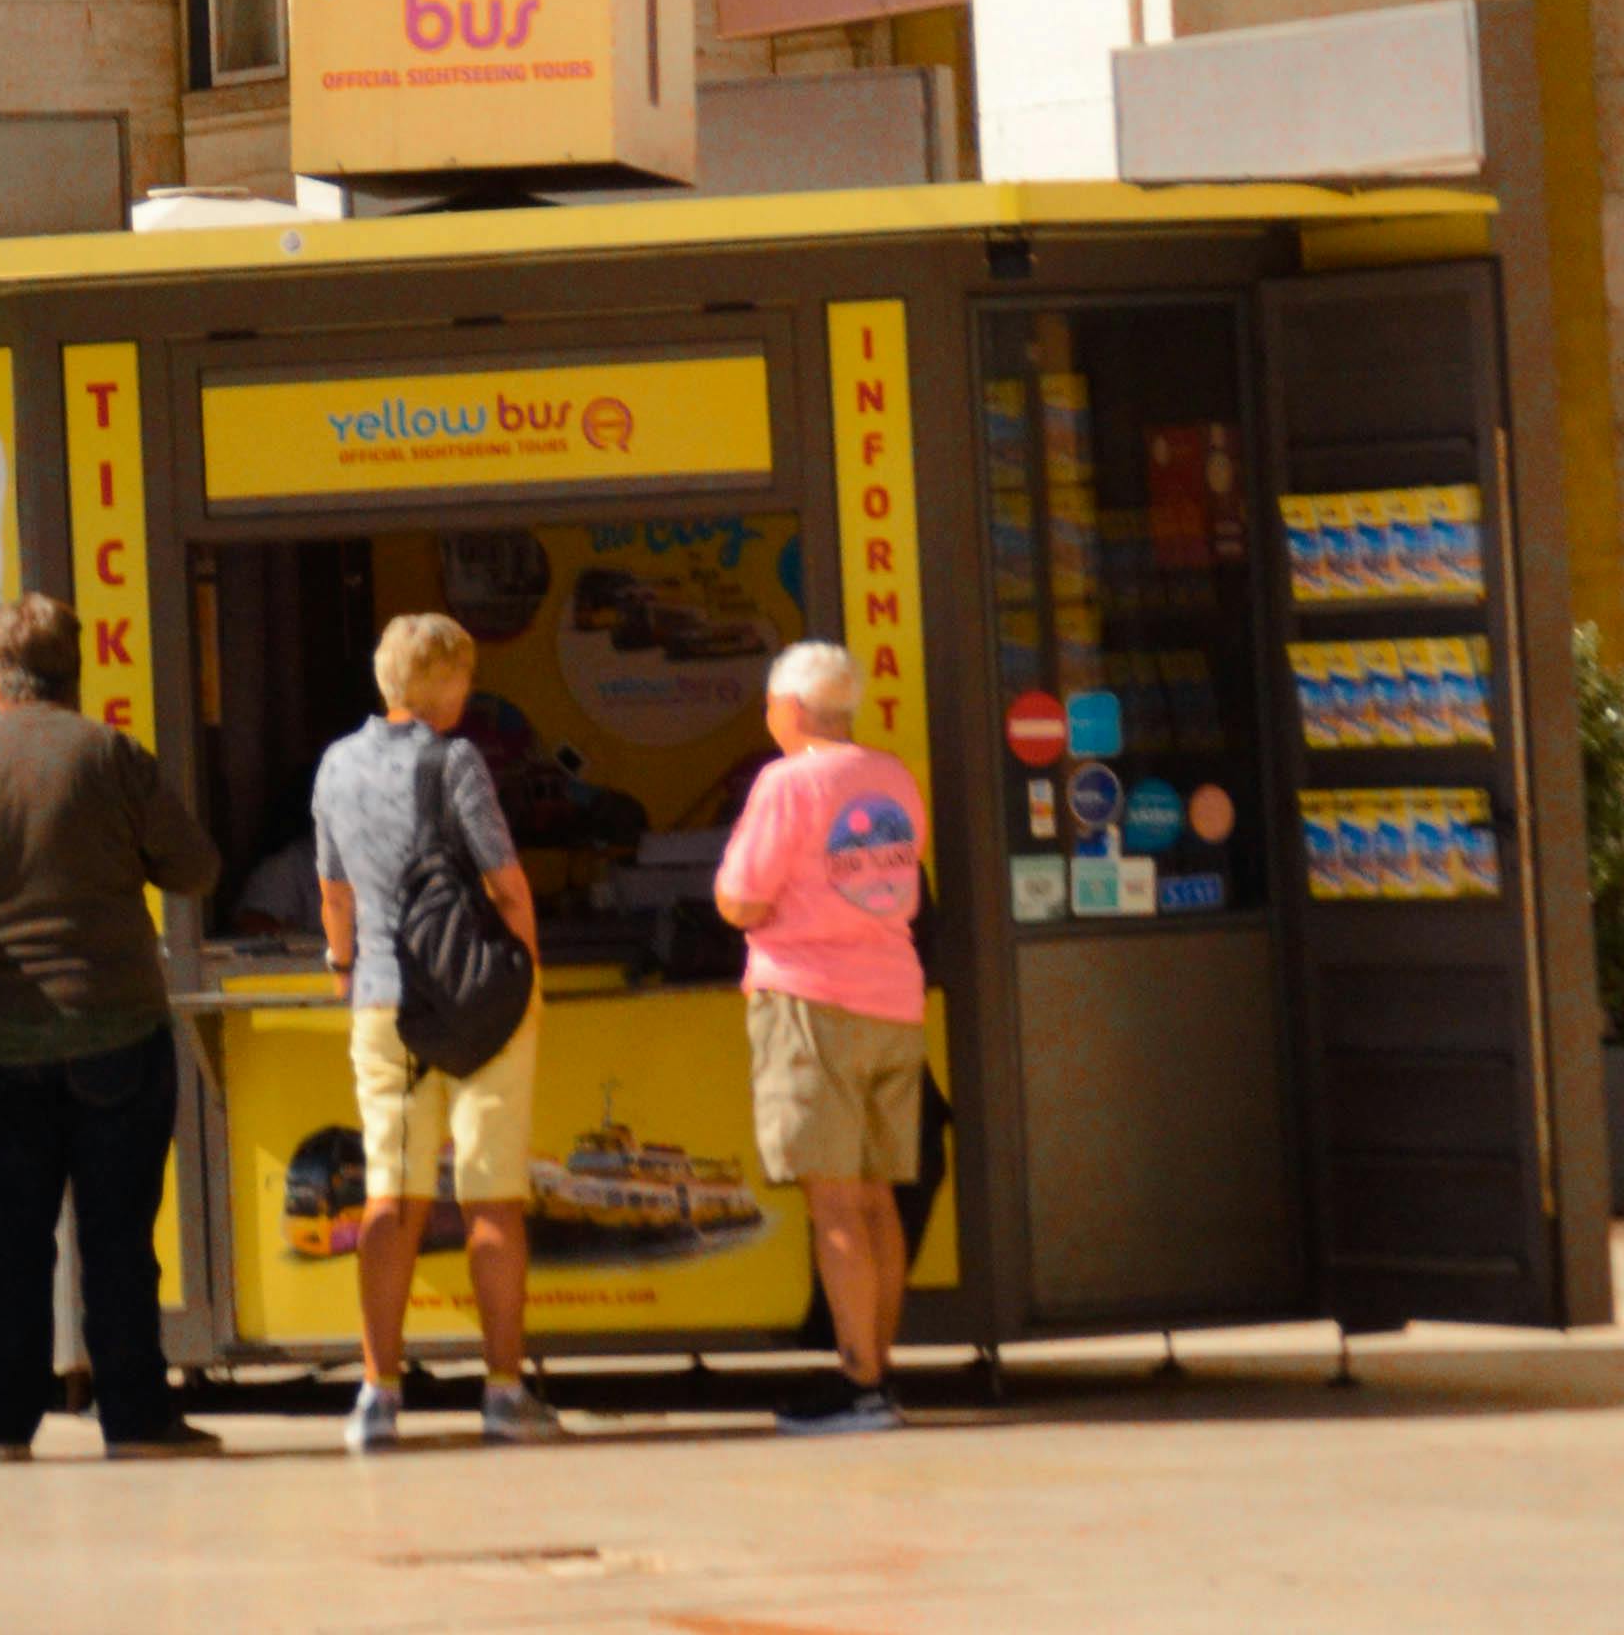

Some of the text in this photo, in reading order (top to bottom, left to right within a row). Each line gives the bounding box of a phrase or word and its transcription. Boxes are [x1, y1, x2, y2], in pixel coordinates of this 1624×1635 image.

[323, 60, 594, 91] OFFICIAL SIGHTSEEING TOURS
[327, 391, 573, 443] yellow bus
[339, 437, 569, 466] OFFICIAL SIGHTSEEING TOURS
[87, 382, 133, 726] TICKE
[856, 326, 899, 732] INFORMAT
